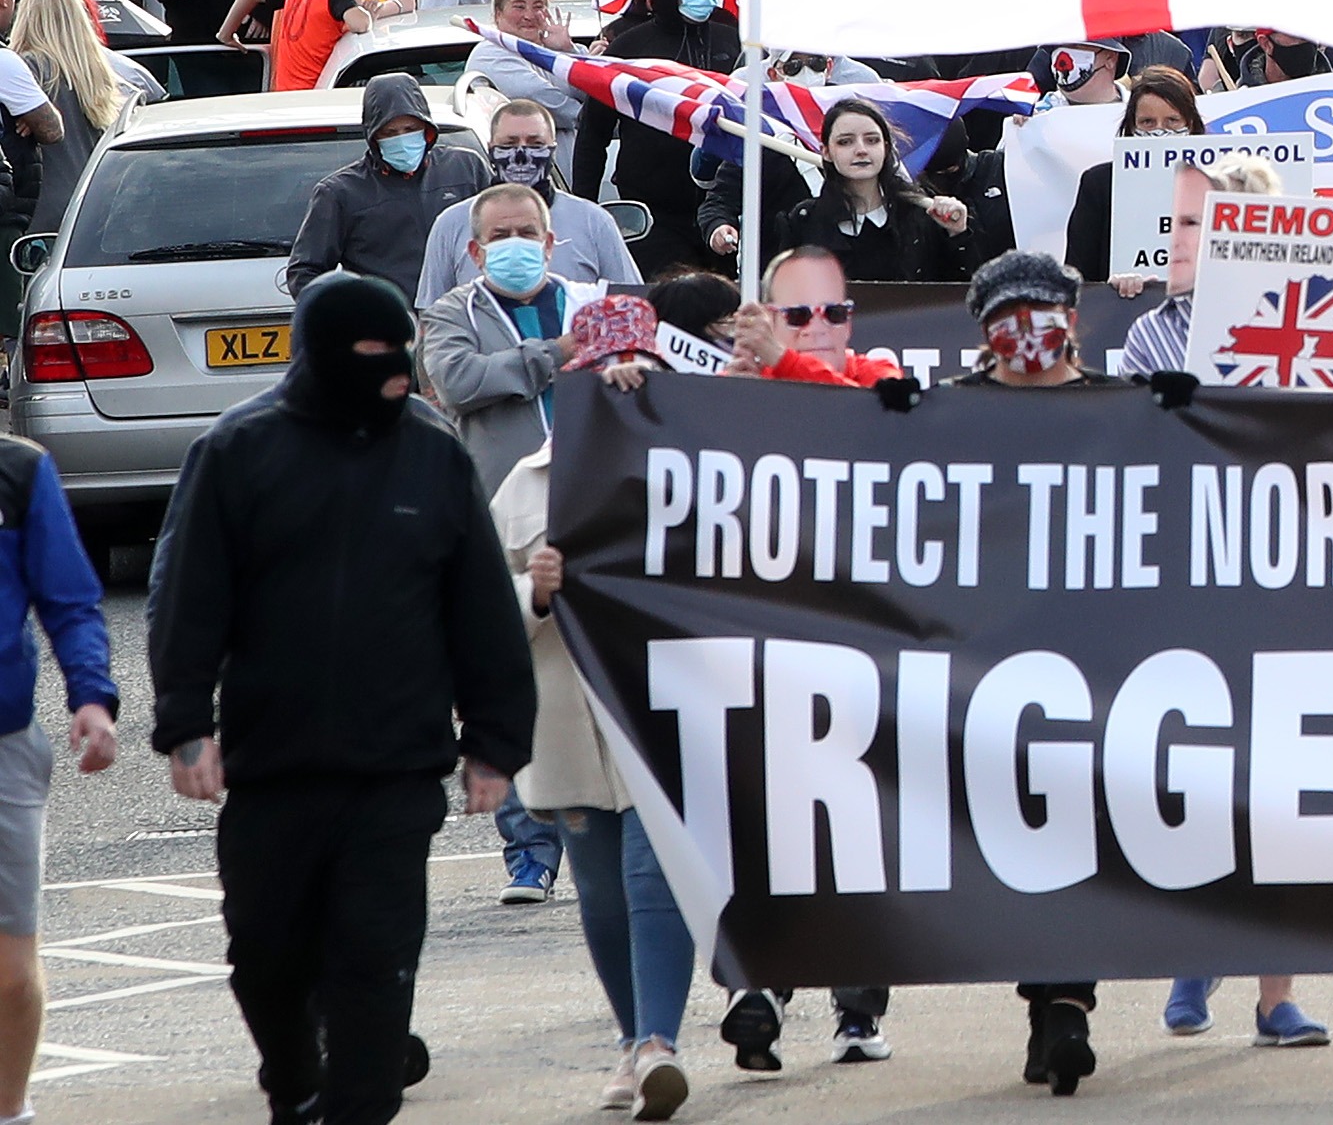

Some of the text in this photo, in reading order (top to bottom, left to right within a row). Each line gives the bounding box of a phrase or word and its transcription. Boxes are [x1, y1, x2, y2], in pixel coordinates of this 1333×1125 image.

[1124, 151, 1151, 169] NI
[1209, 239, 1226, 261] THE
[1228, 240, 1288, 264] NORTHERN
[220, 331, 280, 361] XLZ
[668, 334, 730, 372] ULST
[644, 447, 994, 587] PROTECT
[1016, 463, 1160, 590] THE
